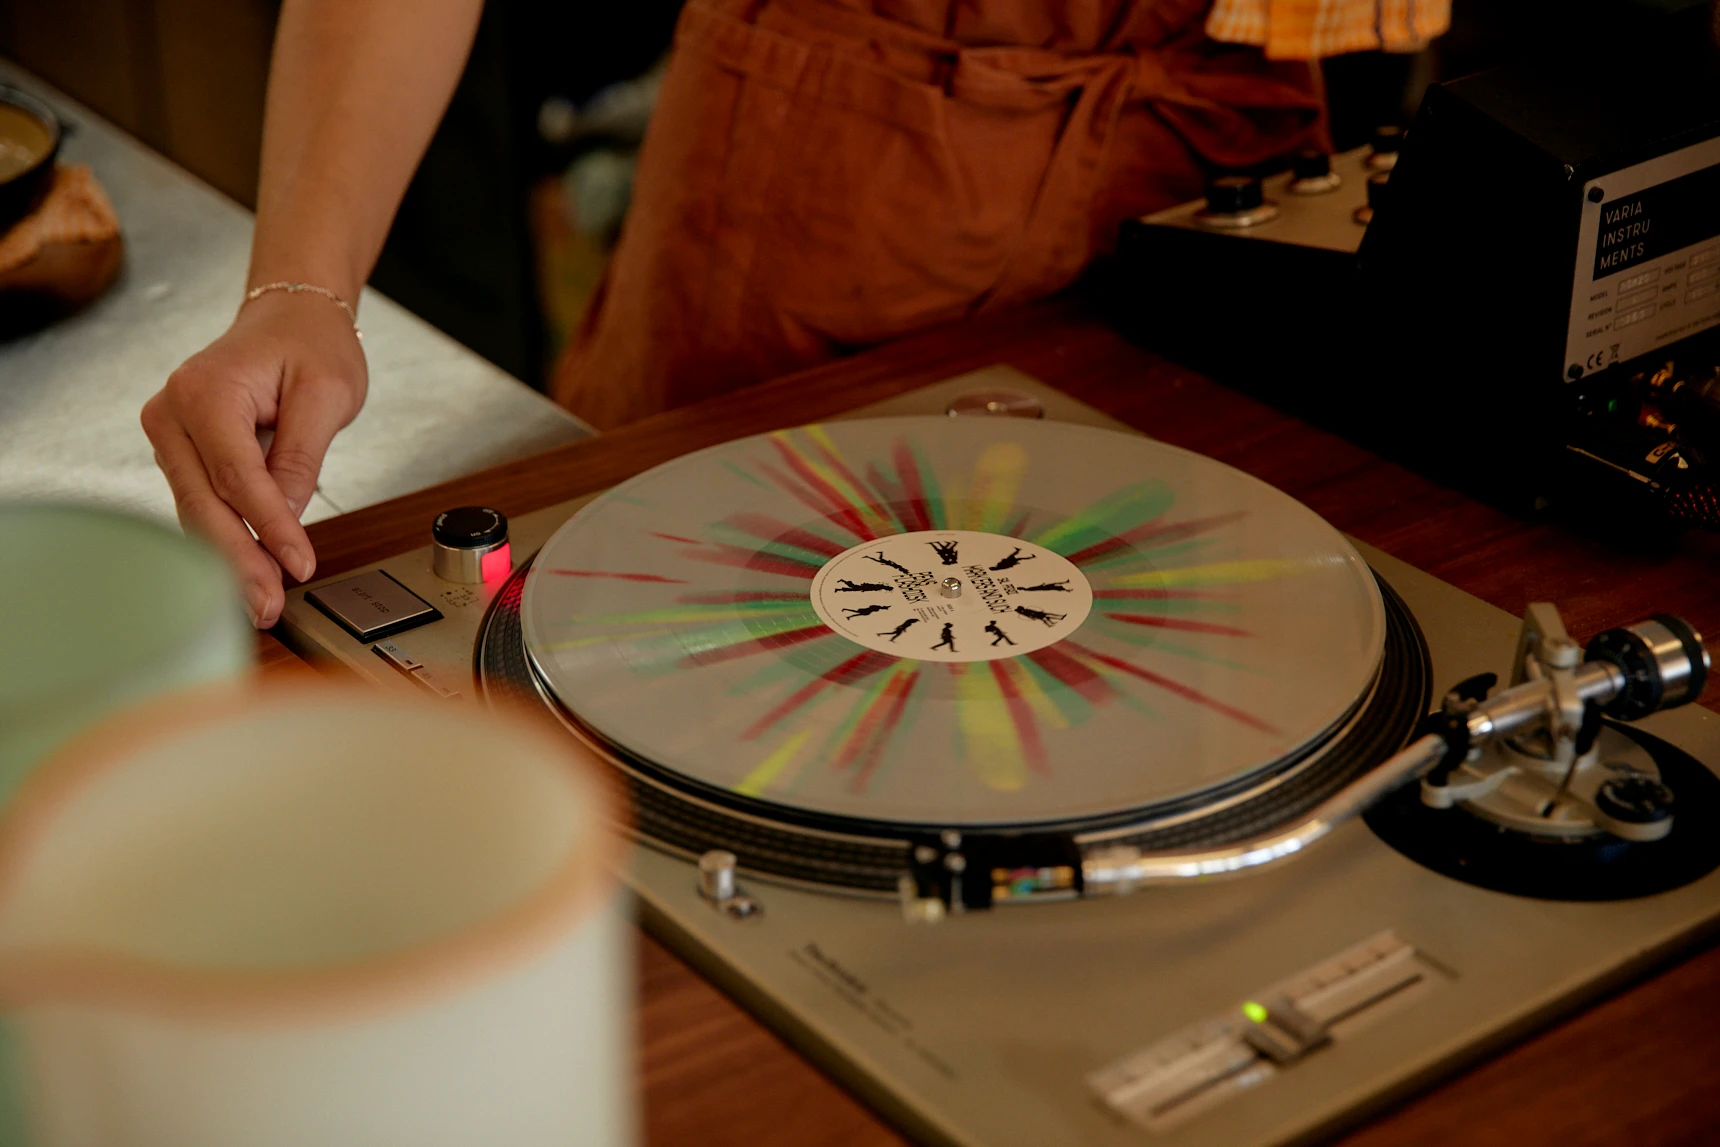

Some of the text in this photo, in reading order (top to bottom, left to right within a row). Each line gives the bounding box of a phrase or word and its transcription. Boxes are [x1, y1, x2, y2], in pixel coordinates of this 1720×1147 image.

[1605, 201, 1642, 225] VARIA
[1602, 219, 1650, 248] INSTRU
[1600, 242, 1644, 270] MENTS
[961, 564, 996, 589] MARKERS
[984, 598, 1014, 614] SUCH
